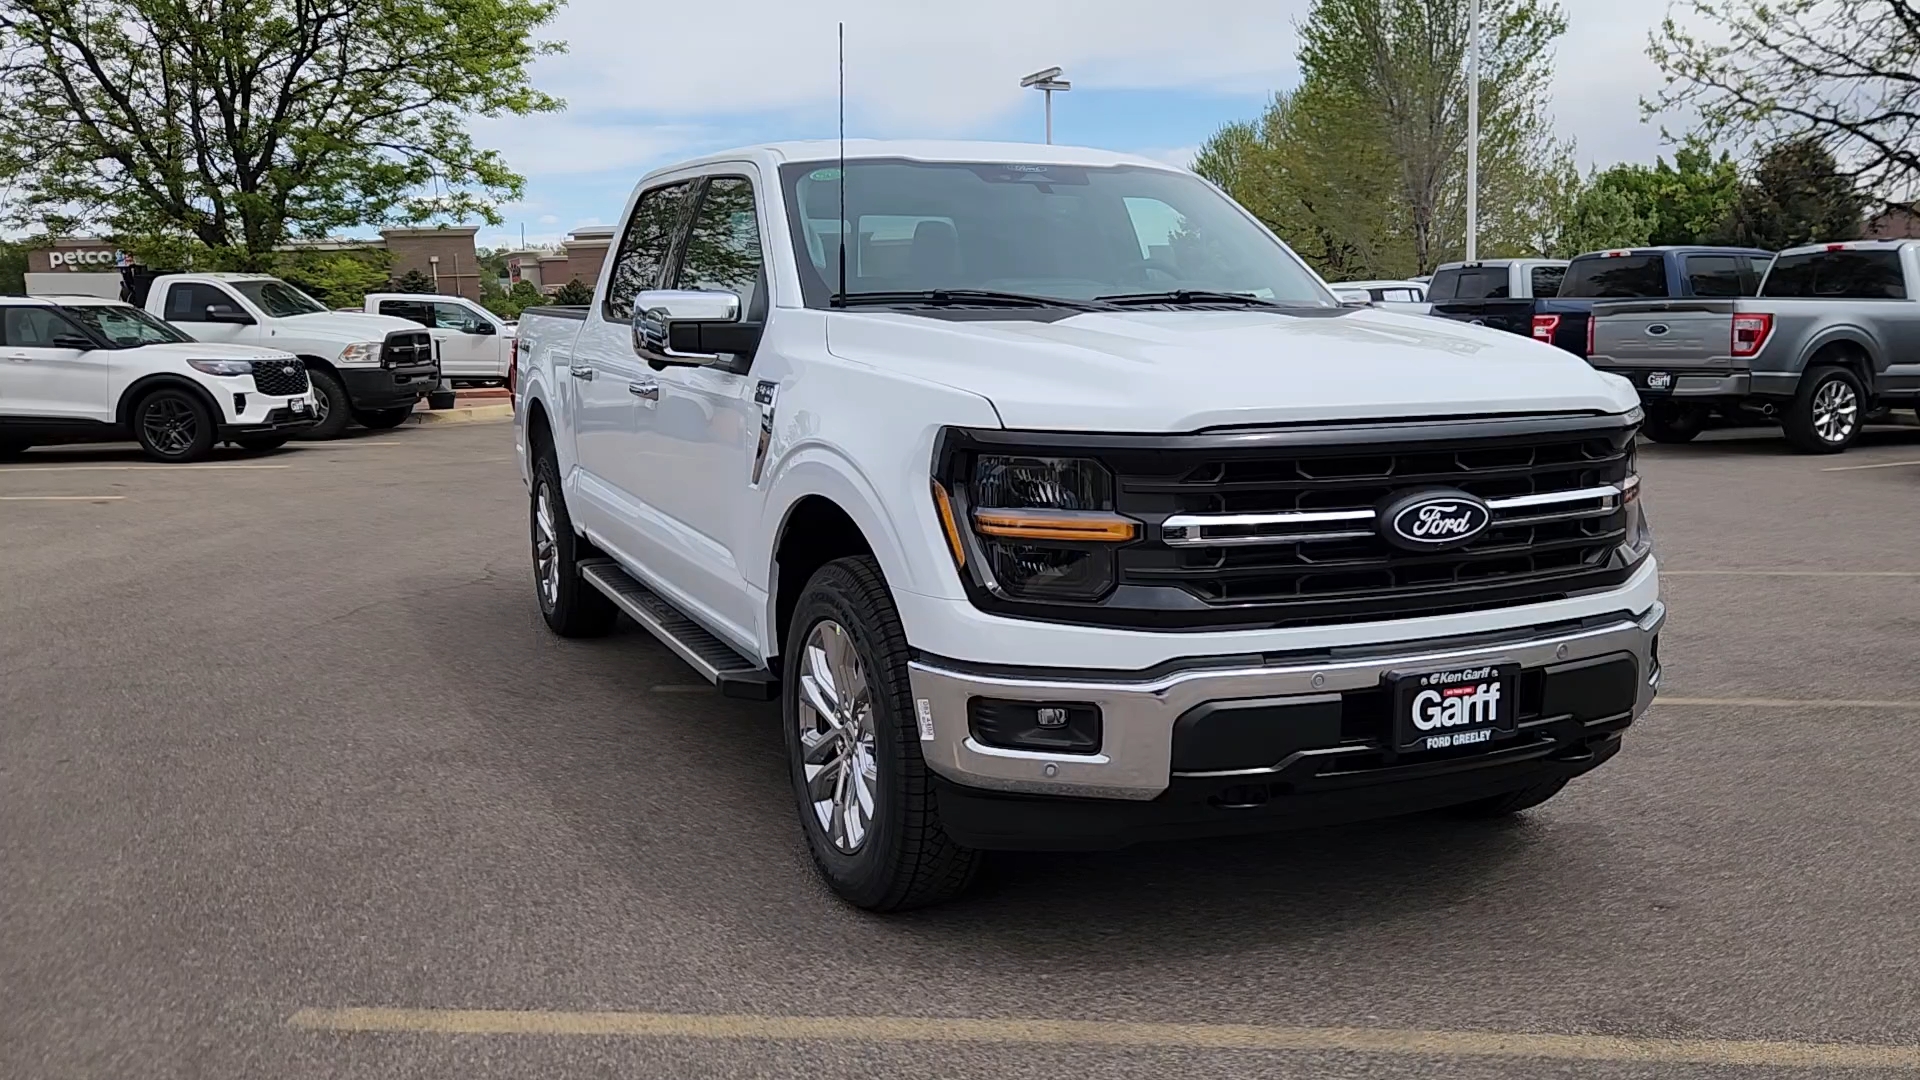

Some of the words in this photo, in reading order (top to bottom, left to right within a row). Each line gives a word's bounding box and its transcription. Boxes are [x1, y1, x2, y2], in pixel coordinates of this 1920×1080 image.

[49, 249, 112, 268] petco
[1413, 505, 1471, 535] Ford
[1440, 671, 1462, 684] Ken
[1463, 667, 1491, 681] Garff
[1412, 682, 1500, 731] Garff
[1427, 735, 1451, 750] FORD
[1453, 730, 1491, 746] GREELEY
